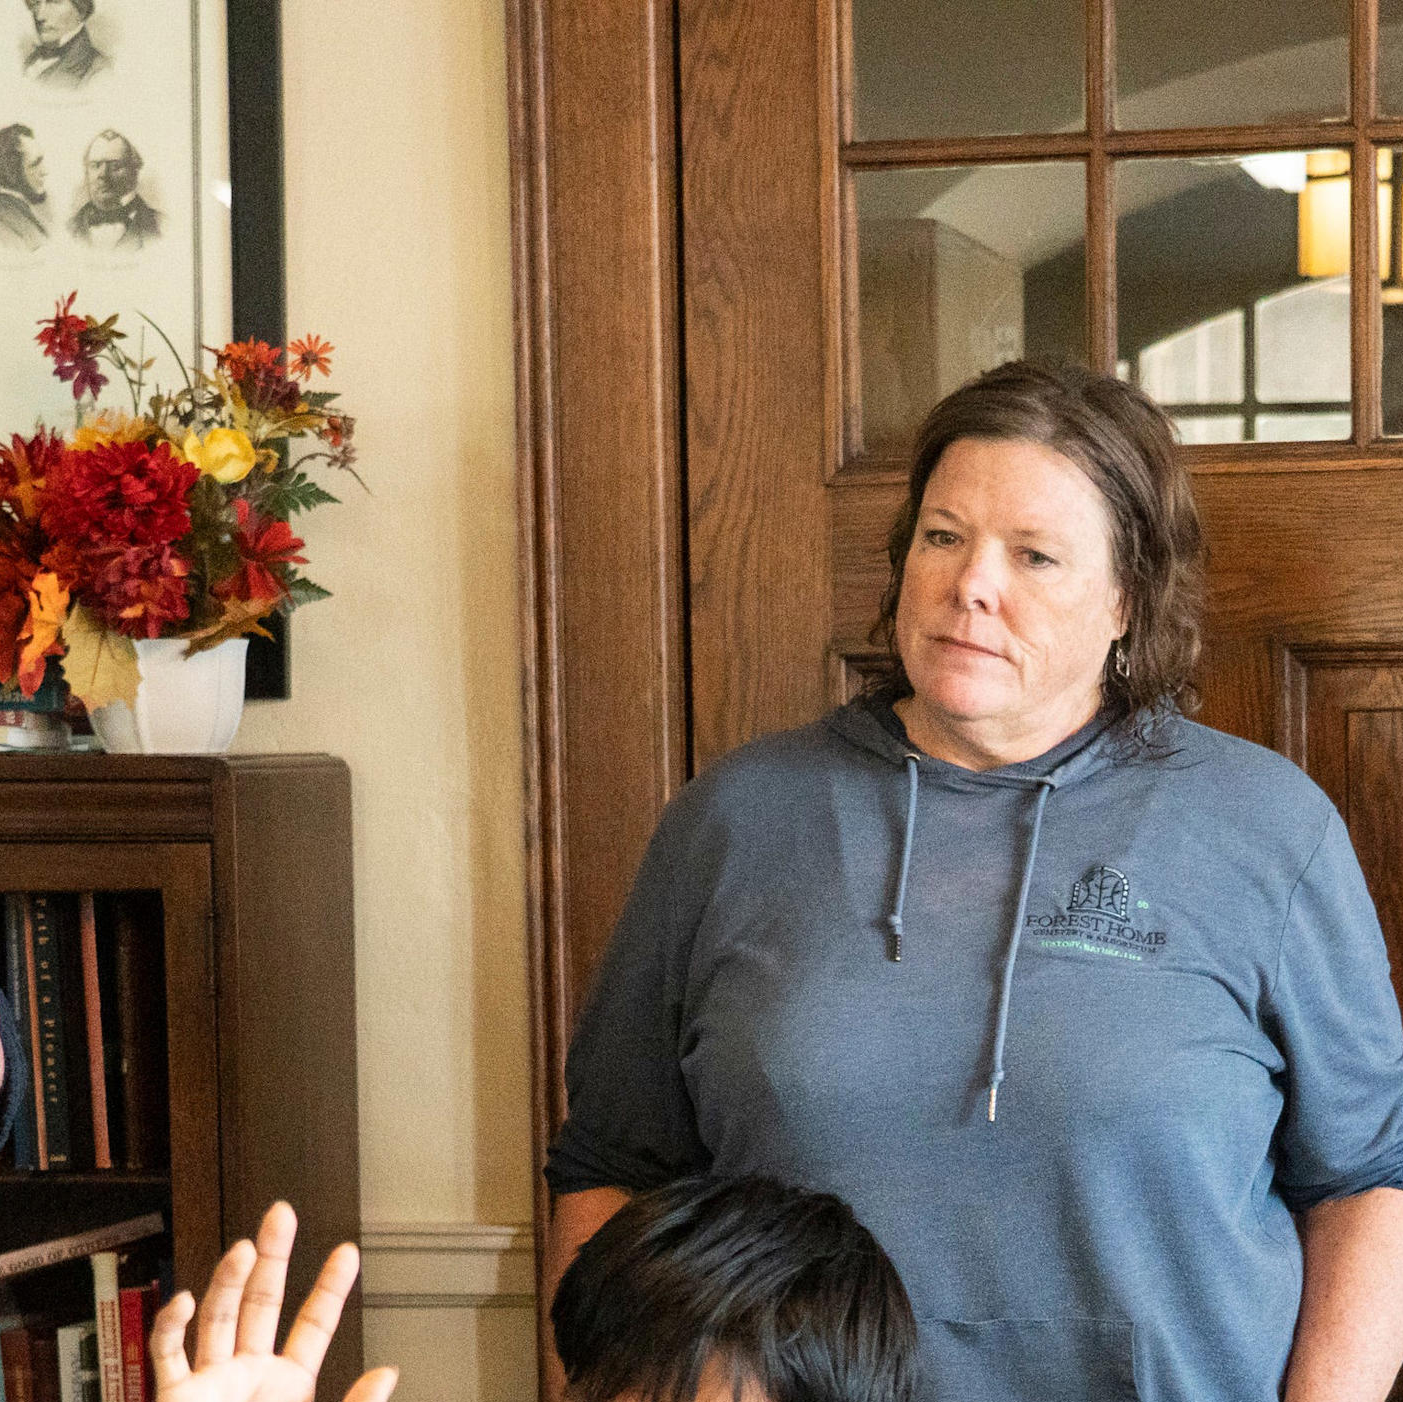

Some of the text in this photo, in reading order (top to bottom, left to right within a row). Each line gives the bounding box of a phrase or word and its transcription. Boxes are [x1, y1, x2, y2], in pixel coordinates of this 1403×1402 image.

[1025, 914, 1167, 946] FOREST HOME
[1032, 928, 1085, 938] CEMETERY
[9, 1255, 45, 1275] GOOD
